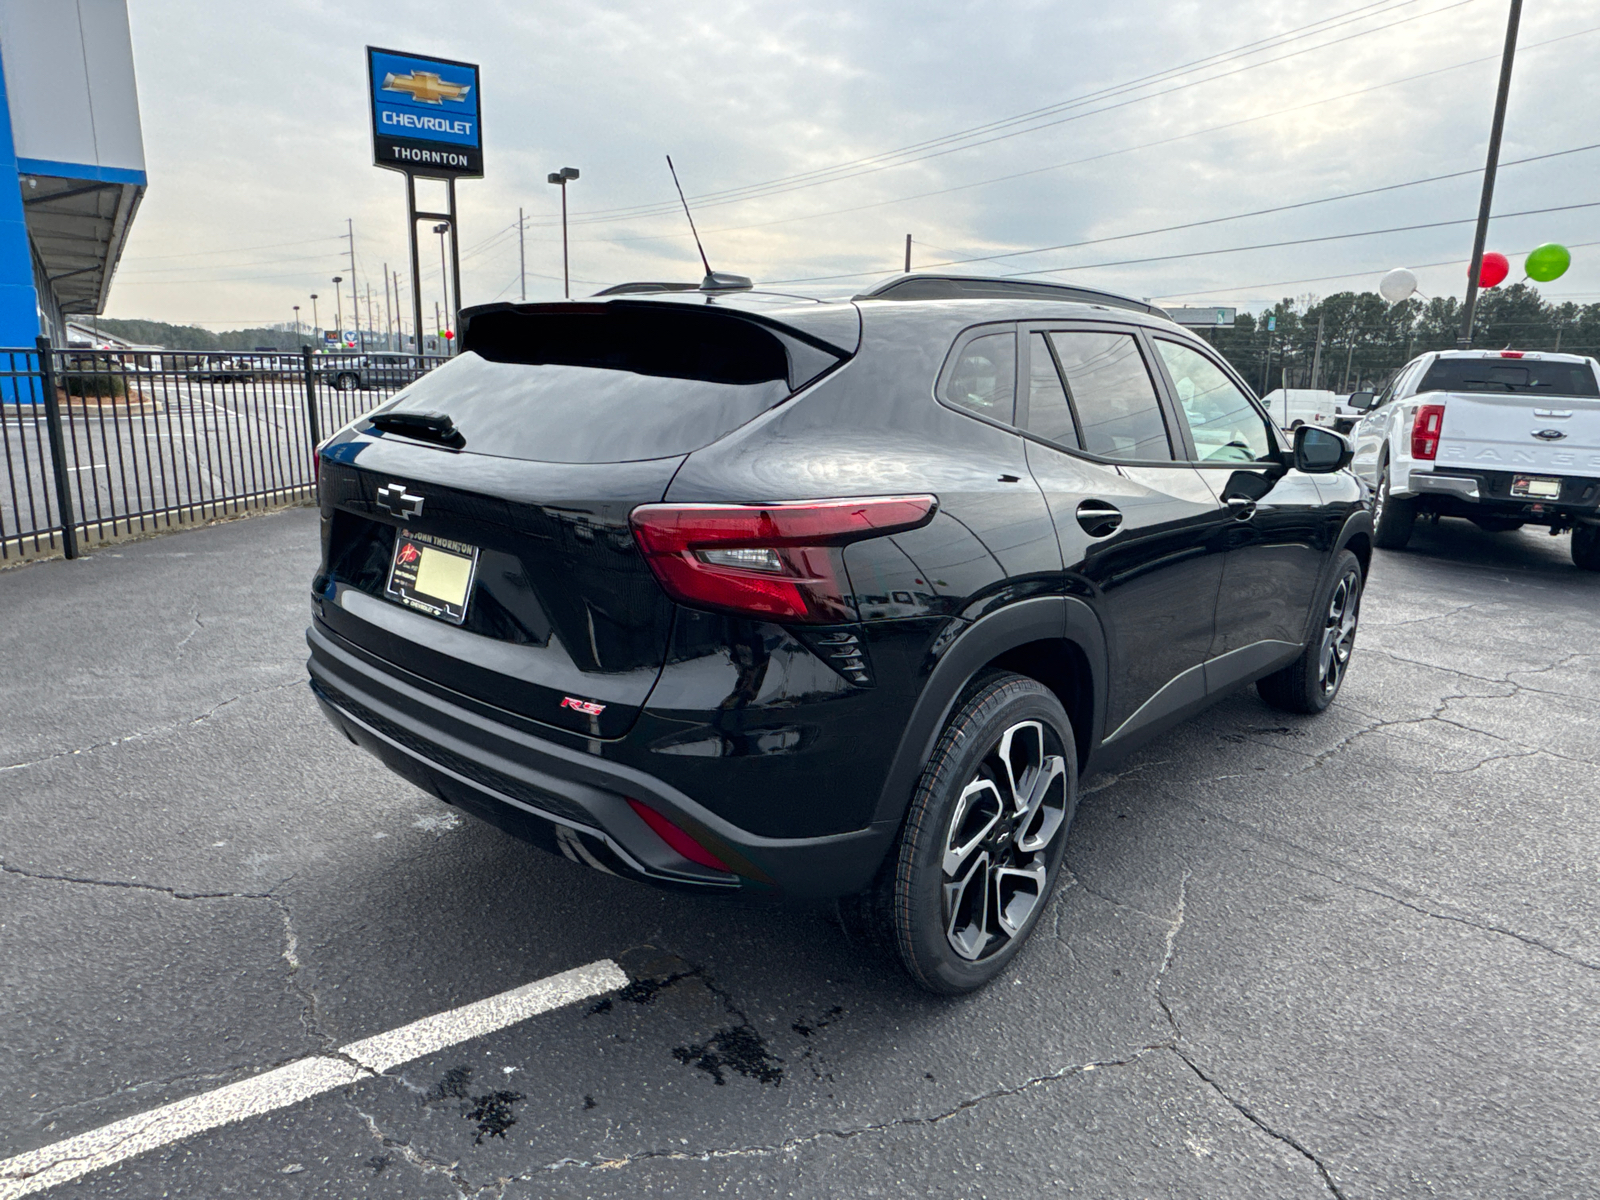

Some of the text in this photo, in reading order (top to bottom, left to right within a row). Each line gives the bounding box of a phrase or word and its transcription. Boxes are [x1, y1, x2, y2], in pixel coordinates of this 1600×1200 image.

[382, 110, 472, 135] CHEVROLET
[392, 146, 468, 166] THORNTON
[413, 531, 433, 543] JOHN
[561, 696, 606, 715] RS
